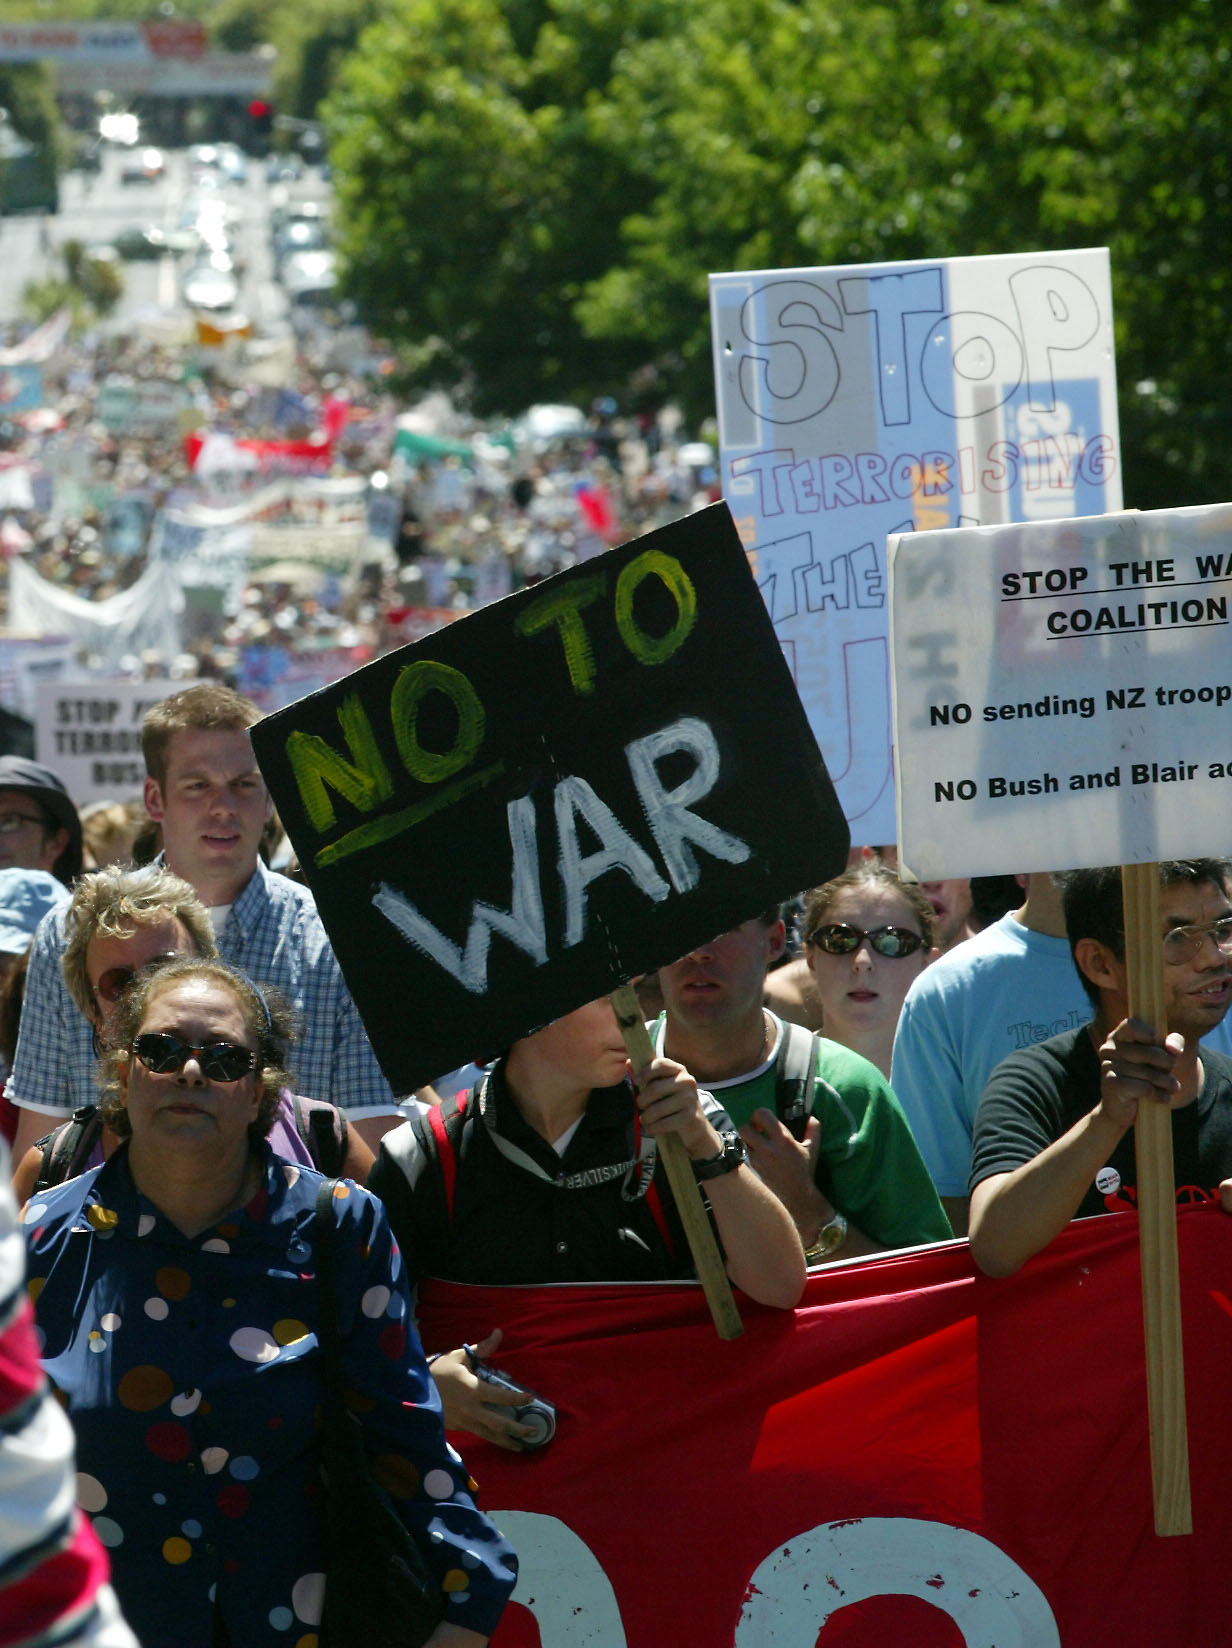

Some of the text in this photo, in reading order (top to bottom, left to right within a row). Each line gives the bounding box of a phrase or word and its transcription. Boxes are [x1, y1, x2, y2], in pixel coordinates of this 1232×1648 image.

[738, 265, 1101, 427] STOP
[730, 433, 1118, 518] TERRORISING
[746, 530, 886, 625] THE
[1001, 566, 1088, 596] STOP
[1109, 559, 1175, 586] THE
[1046, 596, 1228, 635] COALITION
[57, 701, 121, 724] STOP
[285, 659, 487, 835] NO
[513, 548, 698, 694] TO
[929, 703, 973, 727] NO
[982, 695, 1096, 719] sending
[1105, 687, 1147, 711] NZ
[934, 778, 978, 803] NO
[988, 772, 1060, 799] Bush
[1069, 766, 1121, 791] and
[1131, 760, 1199, 786] Blair
[371, 716, 752, 994] WAR
